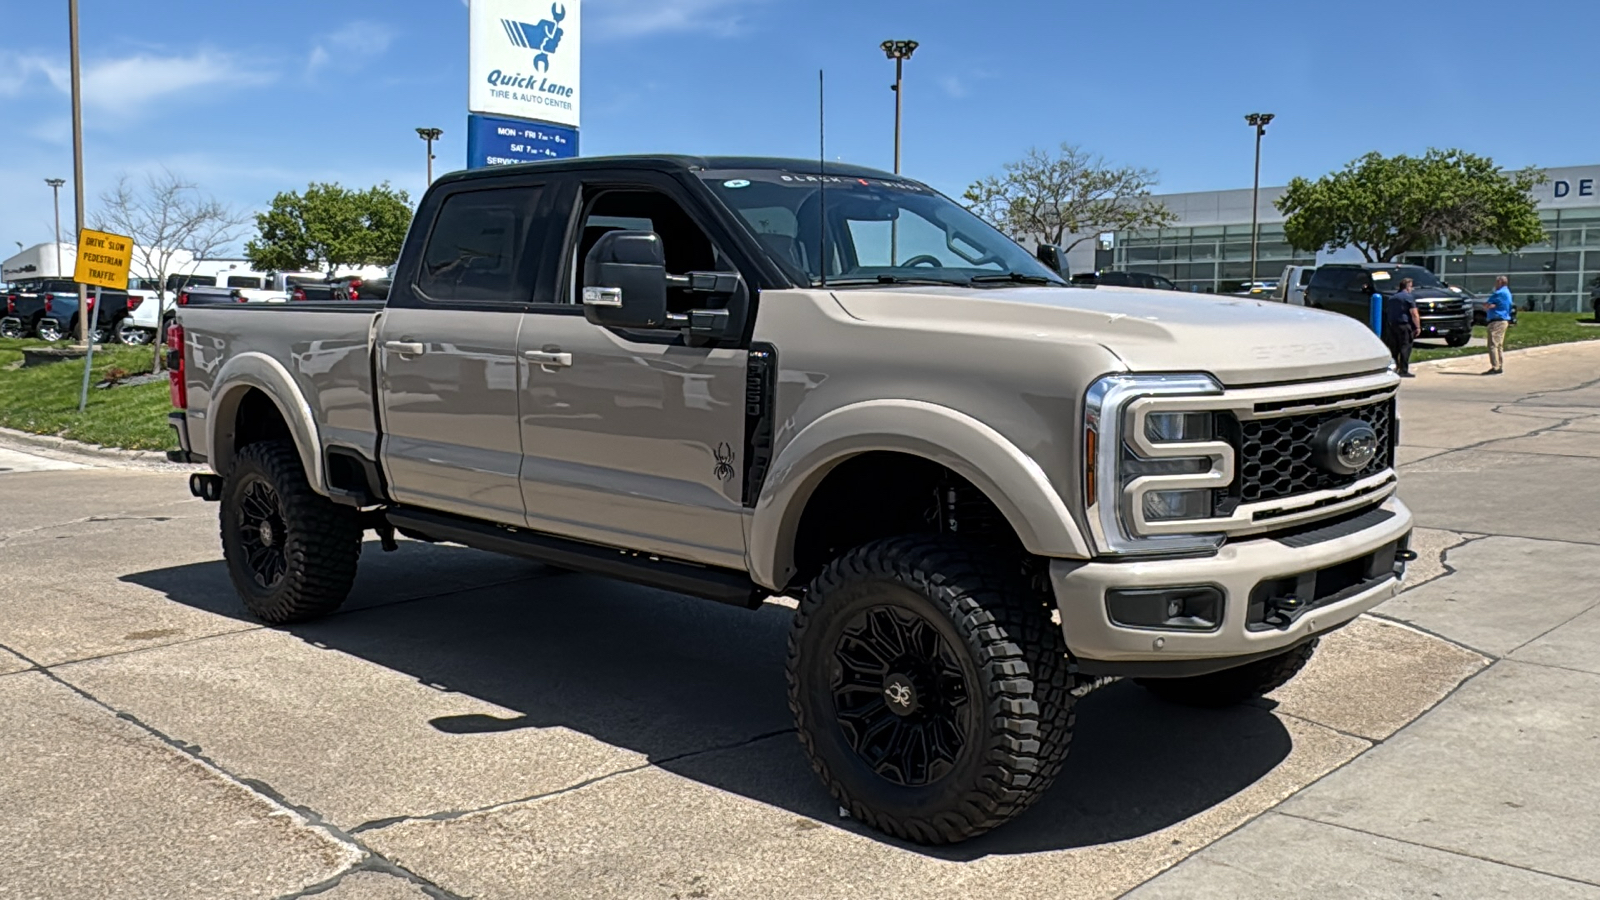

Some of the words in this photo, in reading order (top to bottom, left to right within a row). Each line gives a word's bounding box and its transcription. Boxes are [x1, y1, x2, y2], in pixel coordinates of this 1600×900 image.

[487, 69, 537, 90] Quick
[538, 77, 573, 98] Lane
[490, 89, 510, 99] TIRE
[512, 92, 518, 101] &
[520, 93, 543, 104] AUTO
[544, 97, 572, 111] CENTER
[497, 127, 516, 137] MON
[524, 130, 536, 139] FRI
[510, 143, 524, 153] SAT
[86, 237, 105, 248] DRIVE
[108, 241, 125, 252] SLOW
[83, 252, 123, 267] PEDESTRIAN
[88, 268, 115, 281] TRAFFIC
